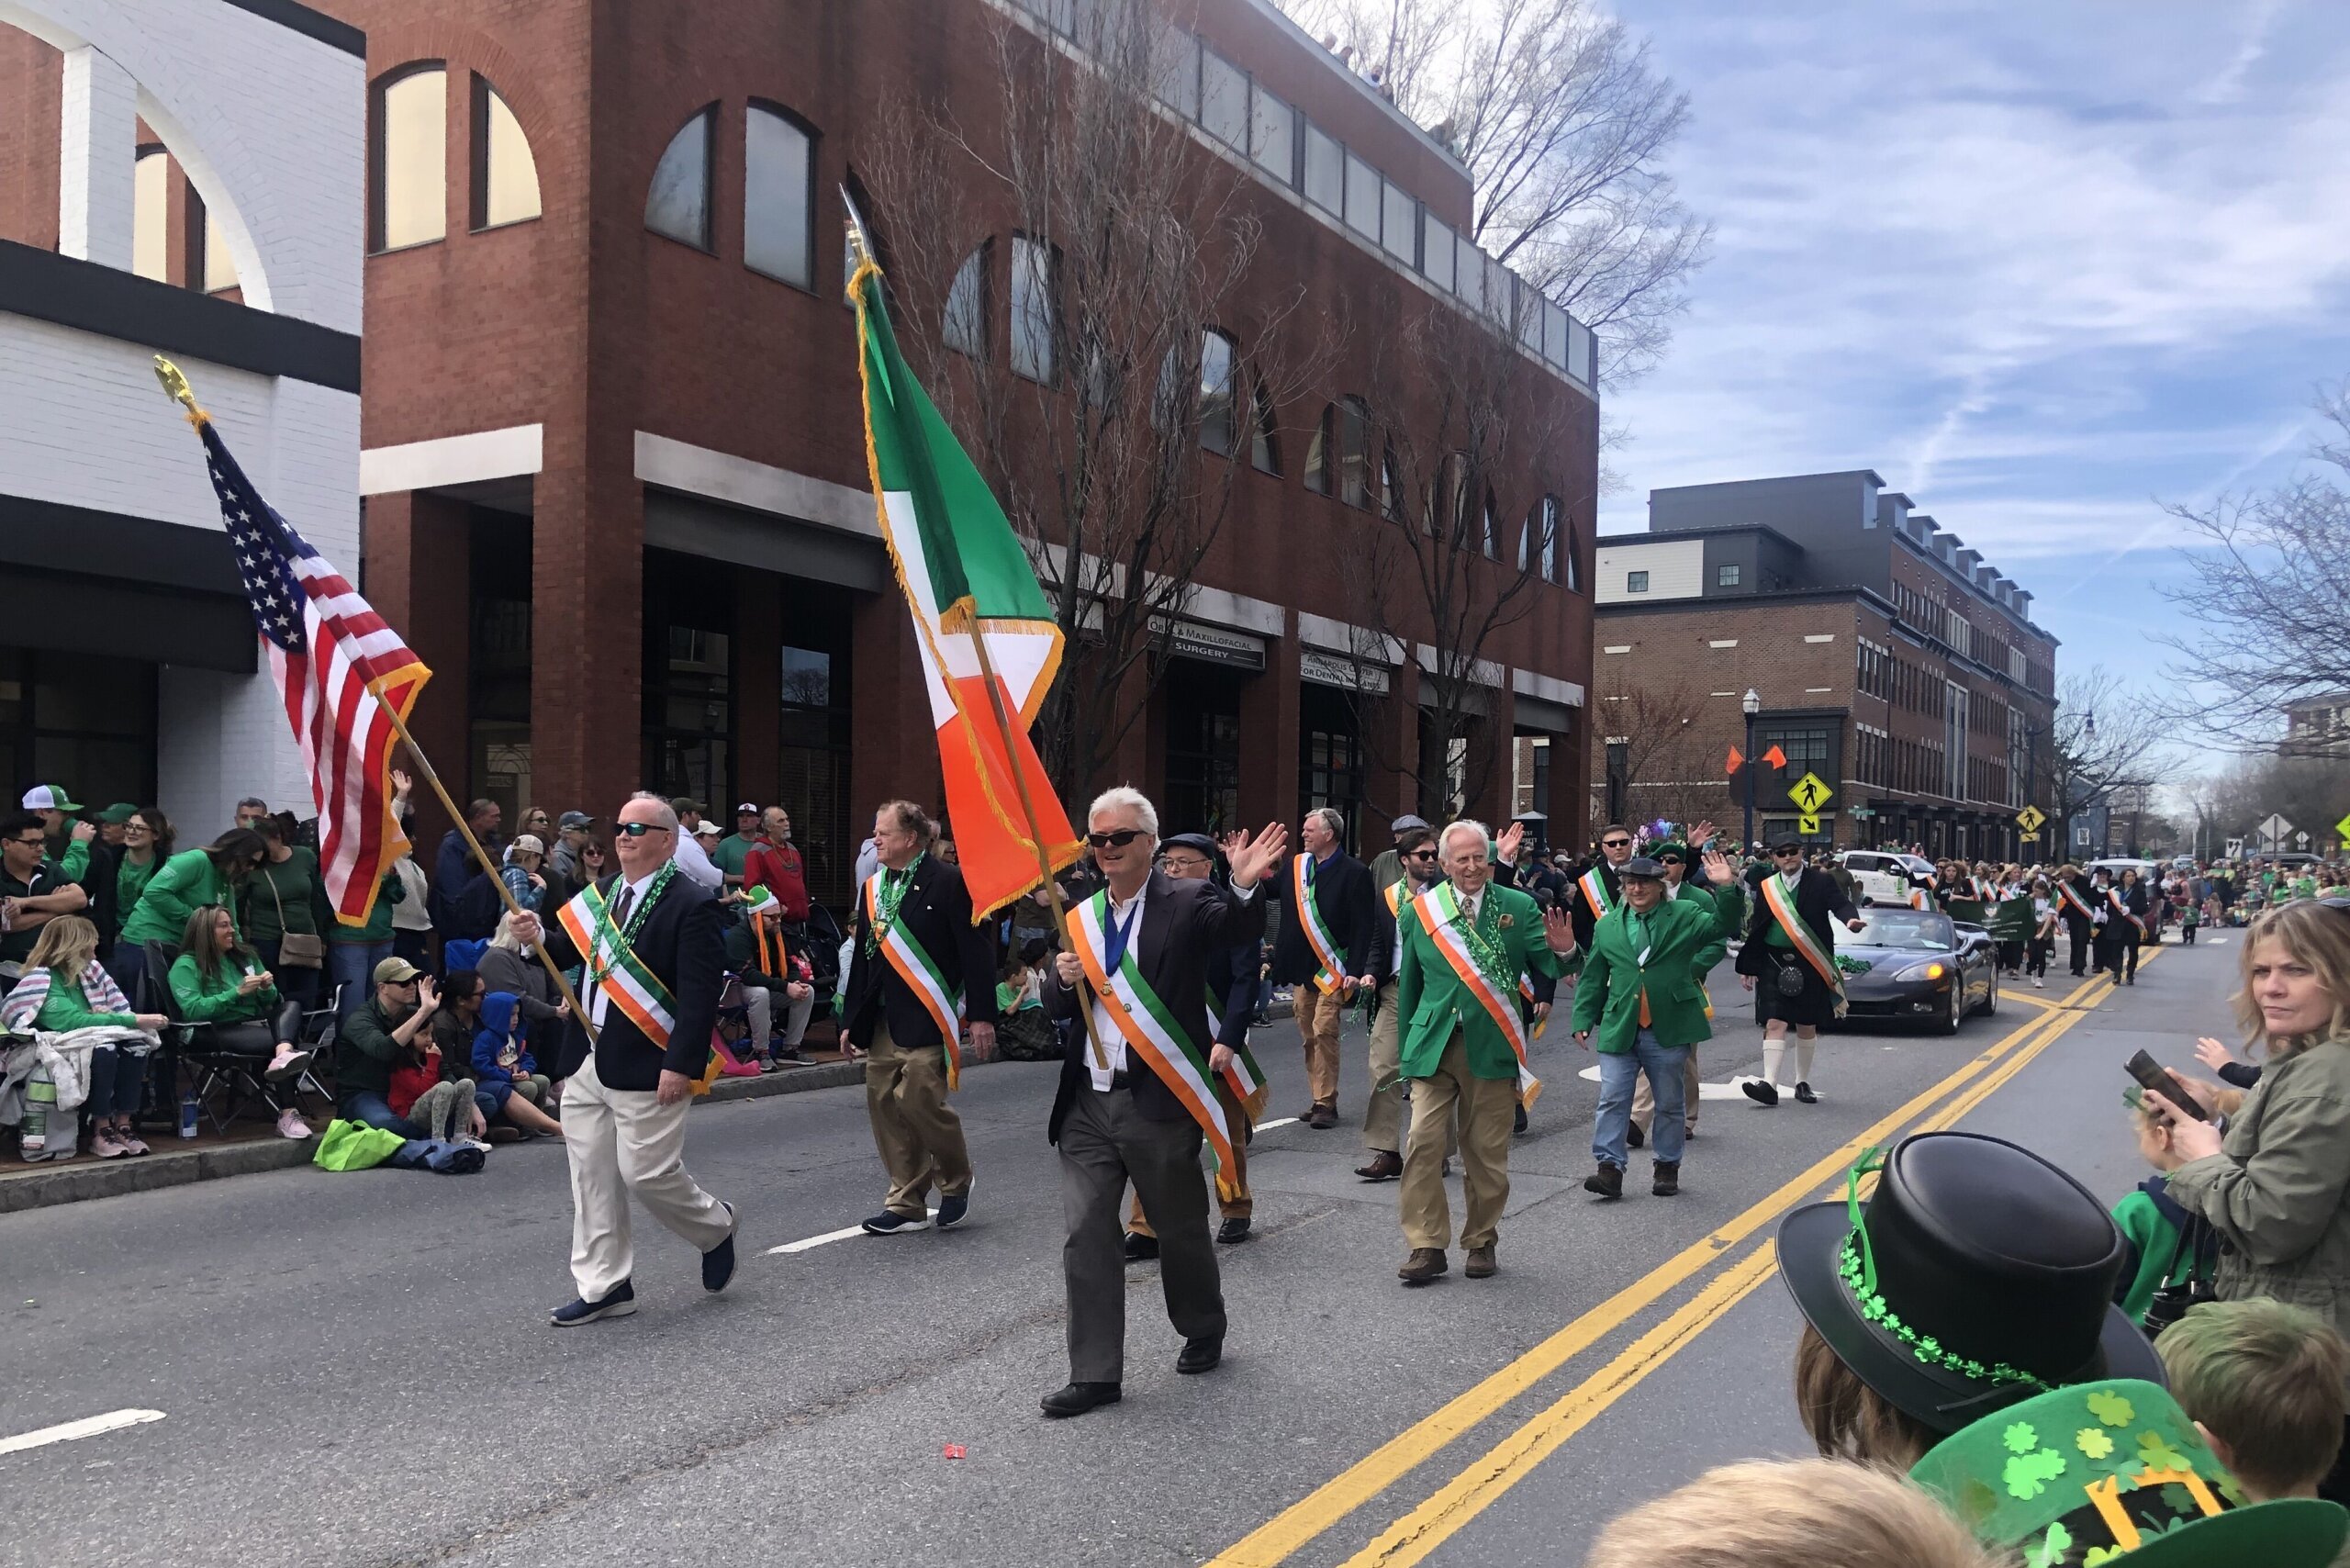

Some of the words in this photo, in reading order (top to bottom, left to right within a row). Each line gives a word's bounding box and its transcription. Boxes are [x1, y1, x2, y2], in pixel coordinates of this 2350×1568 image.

[1186, 629, 1251, 650] MAXILLOFACIAL
[1175, 642, 1229, 659] SURGERY
[1307, 655, 1348, 671] ANNAPOLIS
[1349, 664, 1373, 677] CTER
[1315, 668, 1345, 682] DENTAL
[1346, 676, 1382, 689] IMANTS
